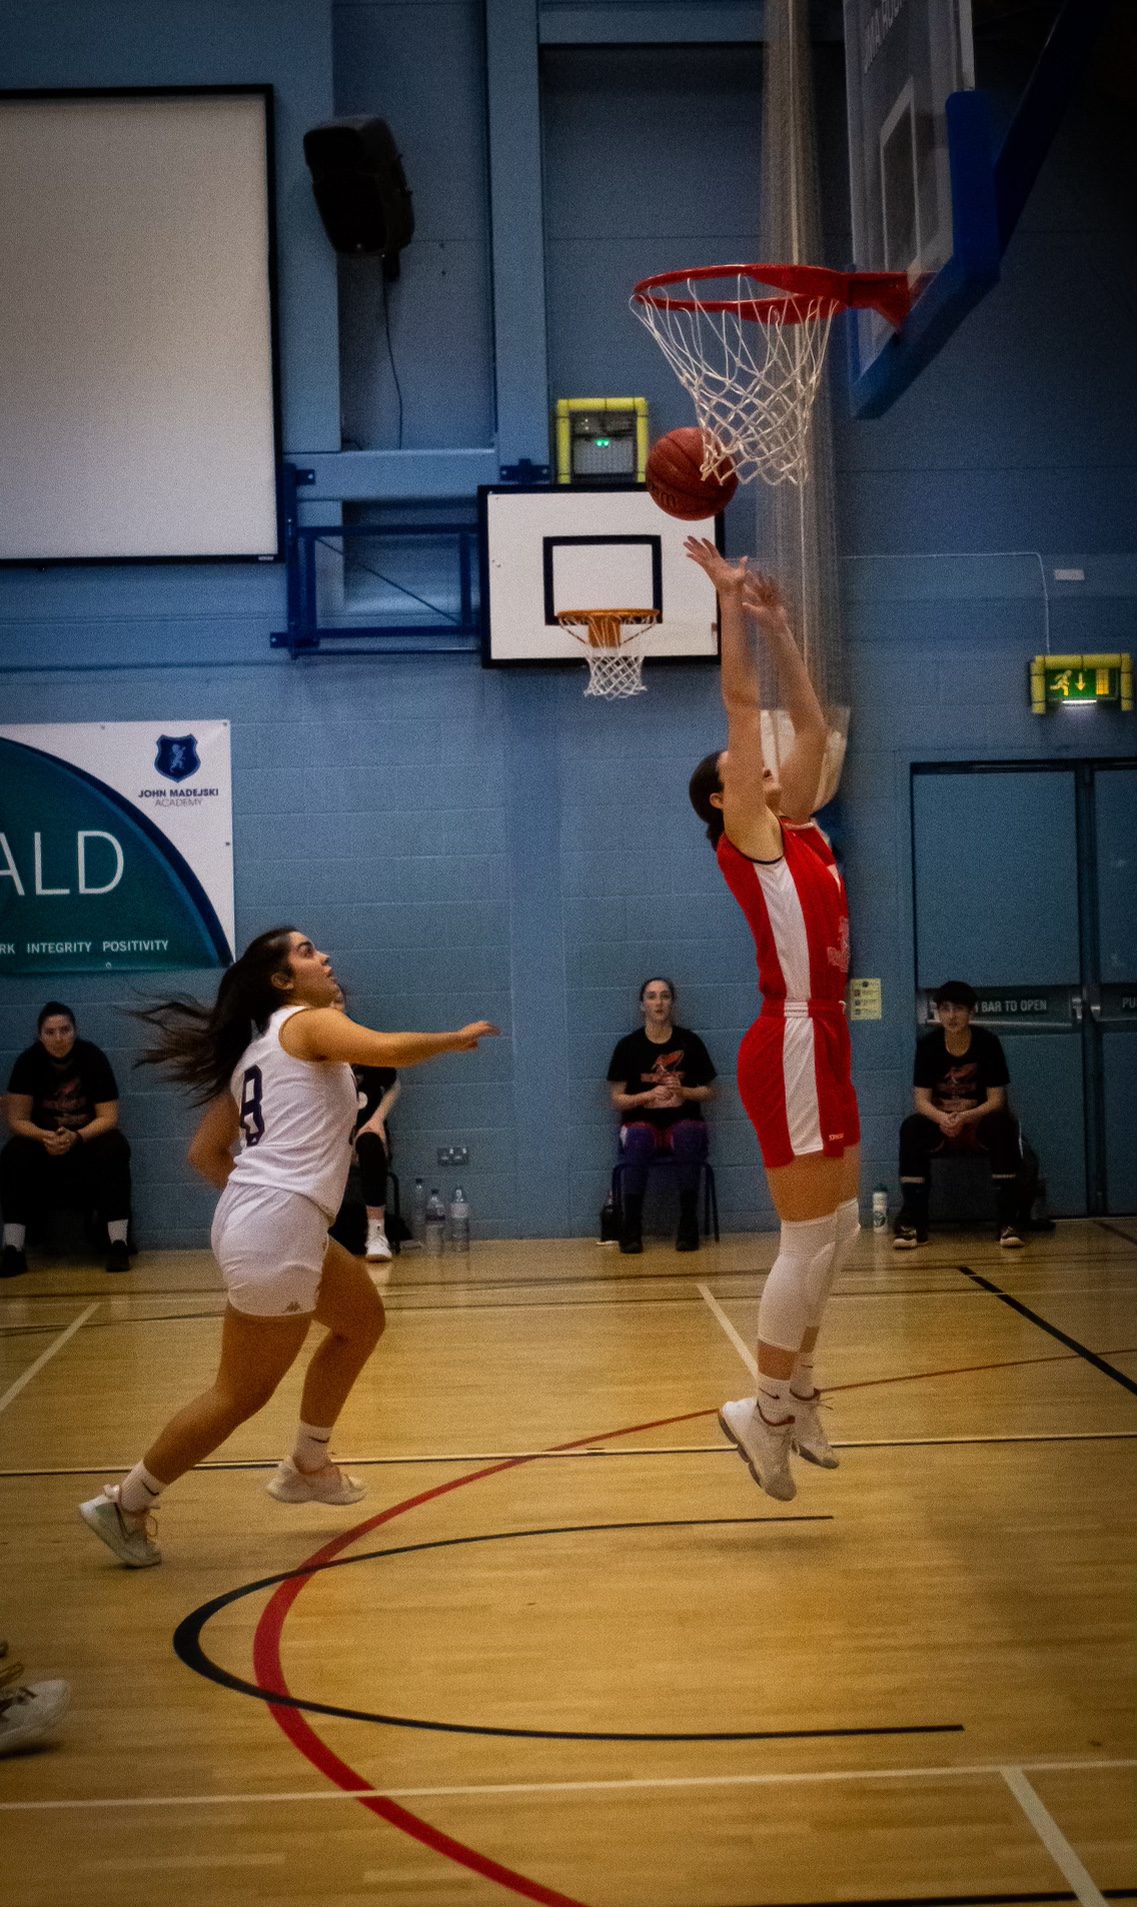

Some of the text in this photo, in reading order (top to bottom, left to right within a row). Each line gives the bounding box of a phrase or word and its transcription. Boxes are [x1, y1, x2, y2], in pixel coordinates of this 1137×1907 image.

[138, 788, 219, 798] JOHN MADEJSKI
[155, 799, 203, 807] ACADEMY
[27, 942, 92, 954] INTEGRITY
[102, 940, 169, 952] POSITIVITY
[981, 1001, 1002, 1013] BAR
[1005, 1000, 1018, 1012] TO
[1020, 999, 1047, 1012] OPEN
